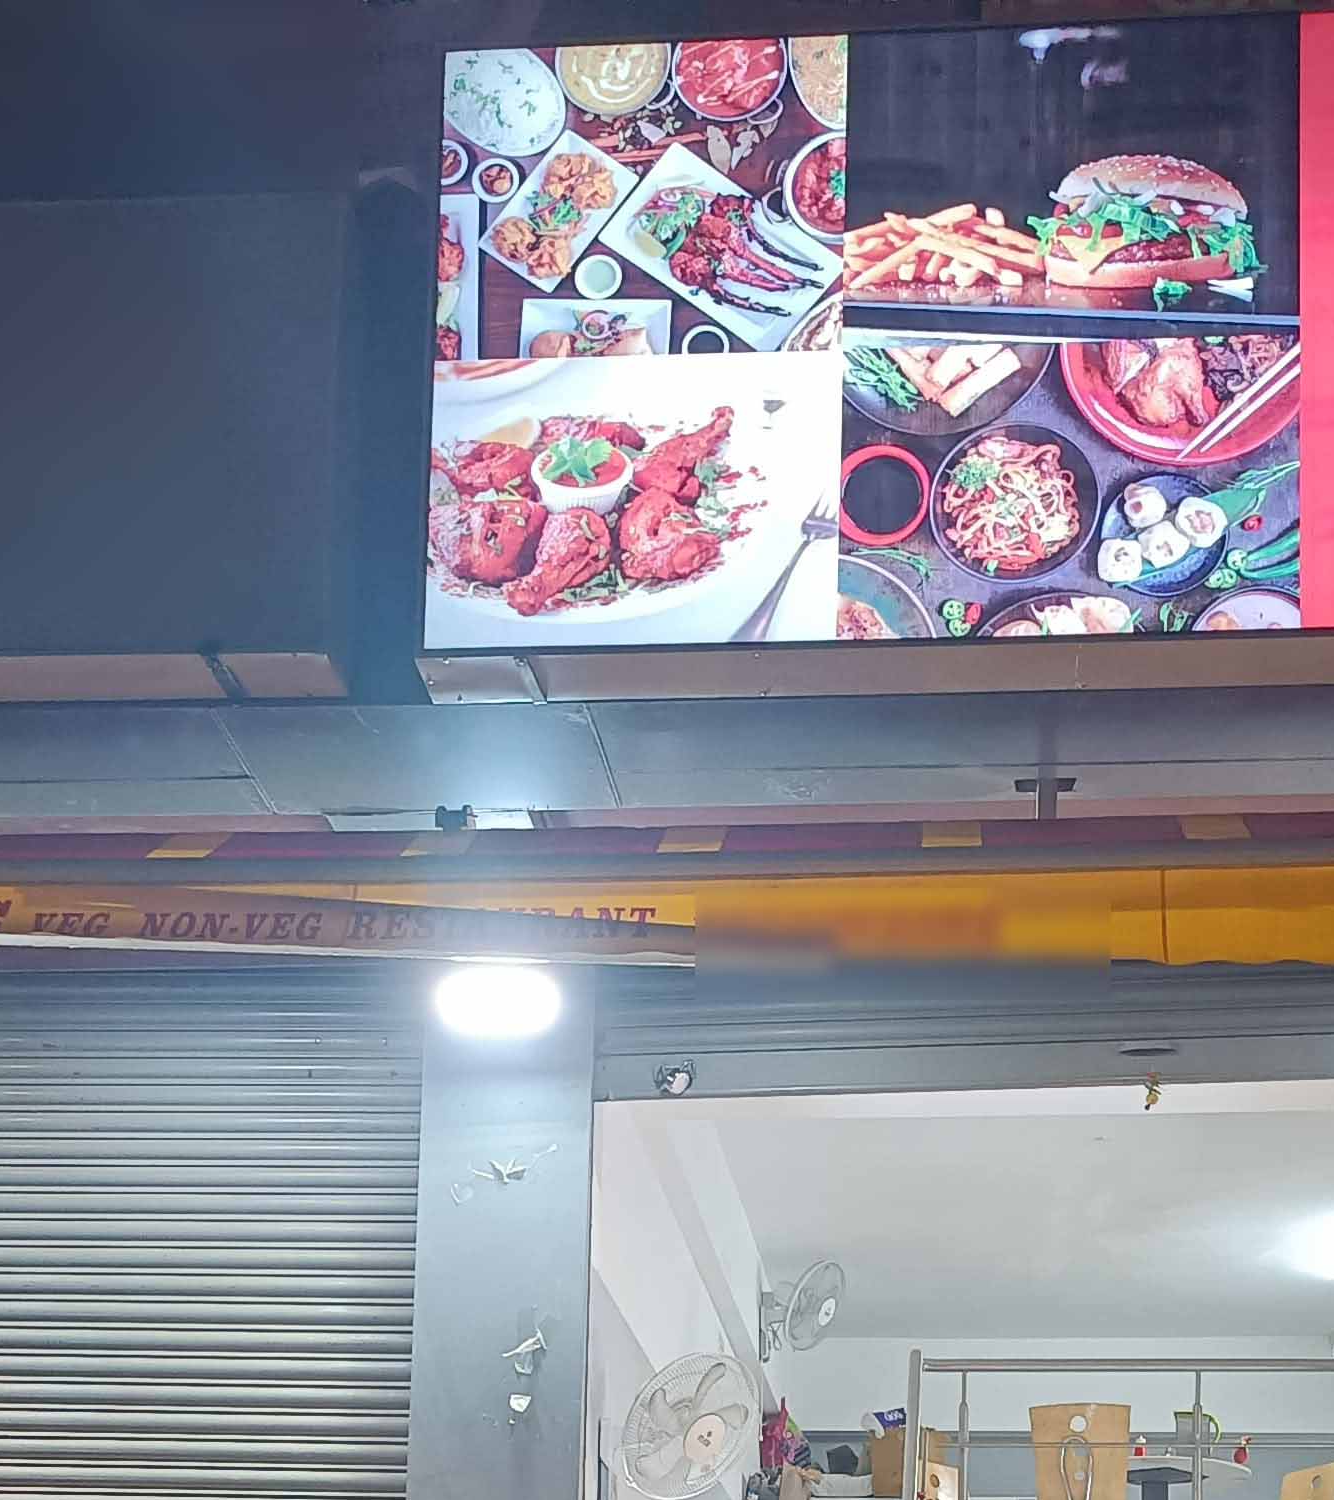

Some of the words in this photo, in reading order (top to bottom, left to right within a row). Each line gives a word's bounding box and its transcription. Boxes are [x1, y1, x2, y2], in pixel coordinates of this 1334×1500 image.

[33, 911, 111, 934] VEG
[138, 910, 326, 940] NON-VEG
[345, 904, 658, 942] RESRANT
